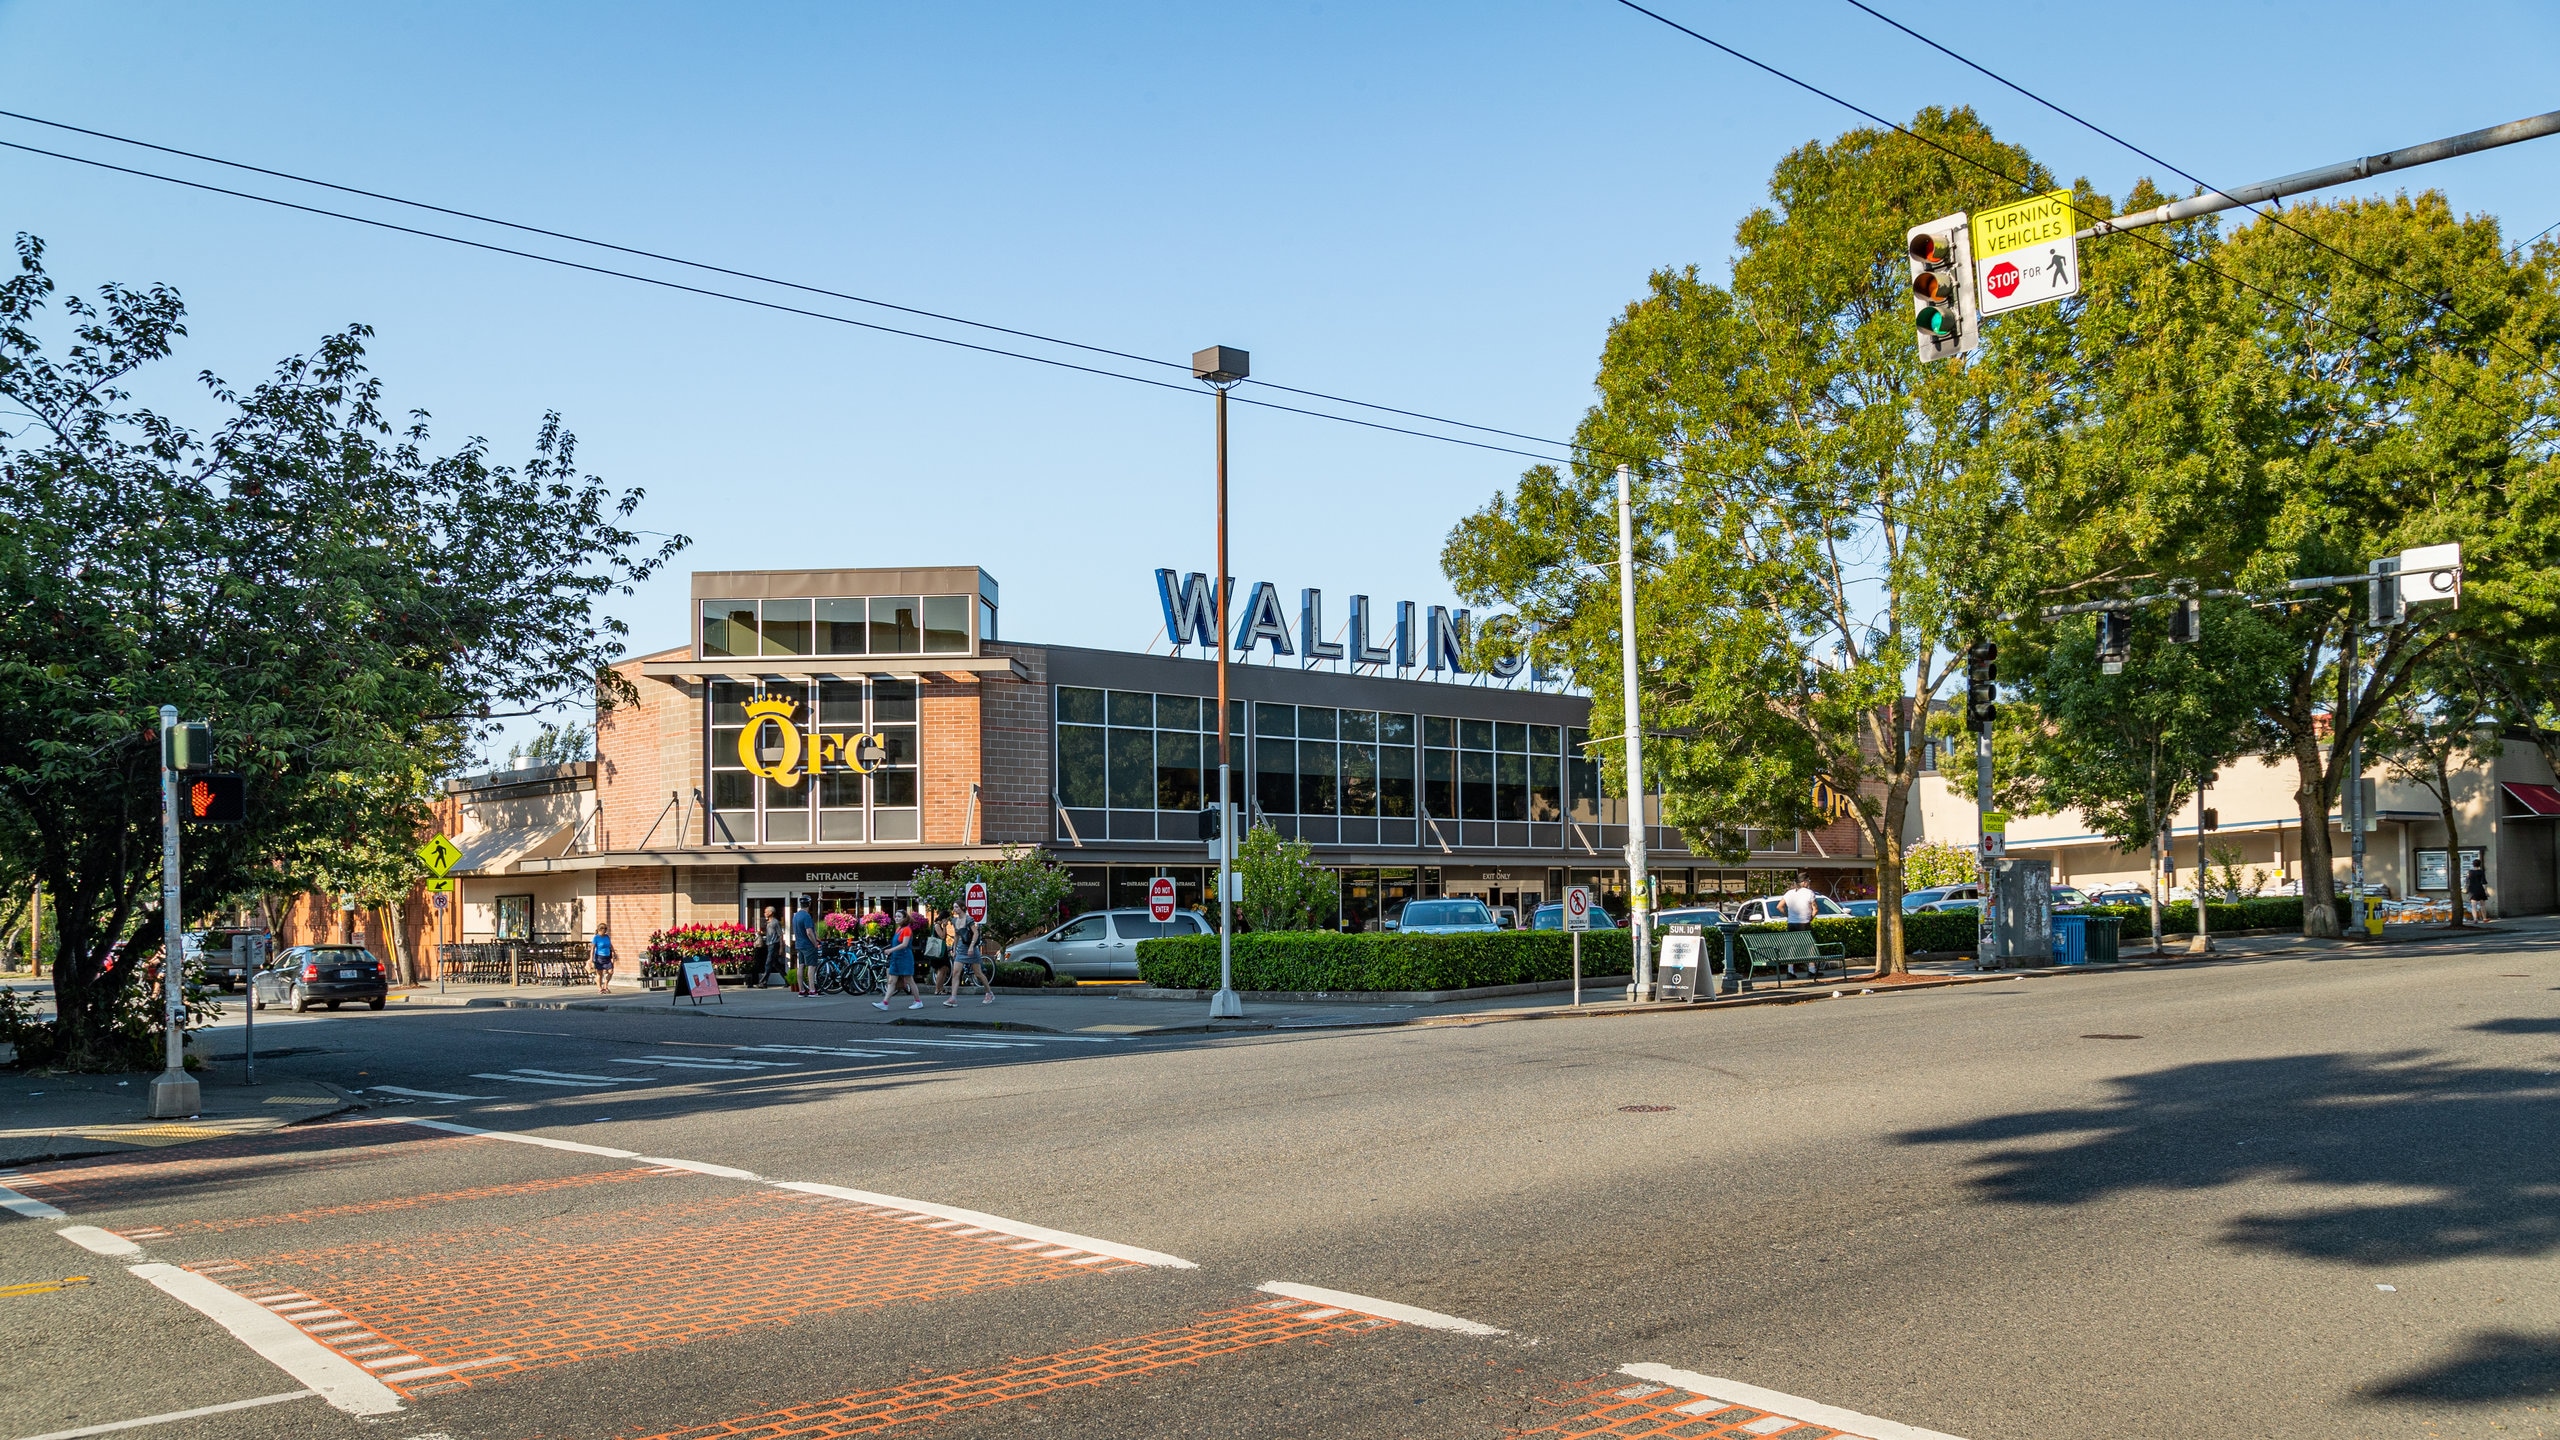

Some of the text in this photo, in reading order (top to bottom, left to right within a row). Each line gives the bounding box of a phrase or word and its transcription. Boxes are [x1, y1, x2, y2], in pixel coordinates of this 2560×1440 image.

[1985, 202, 2062, 233] TURNING
[1988, 221, 2062, 252] VEHICLES
[1988, 266, 2041, 290] STOP FOR
[1155, 567, 1550, 681] WALLING
[738, 714, 885, 788] QFC
[805, 872, 859, 881] ENTRANCE
[1670, 925, 1686, 934] SUN.
[1687, 926, 1694, 934] 10
